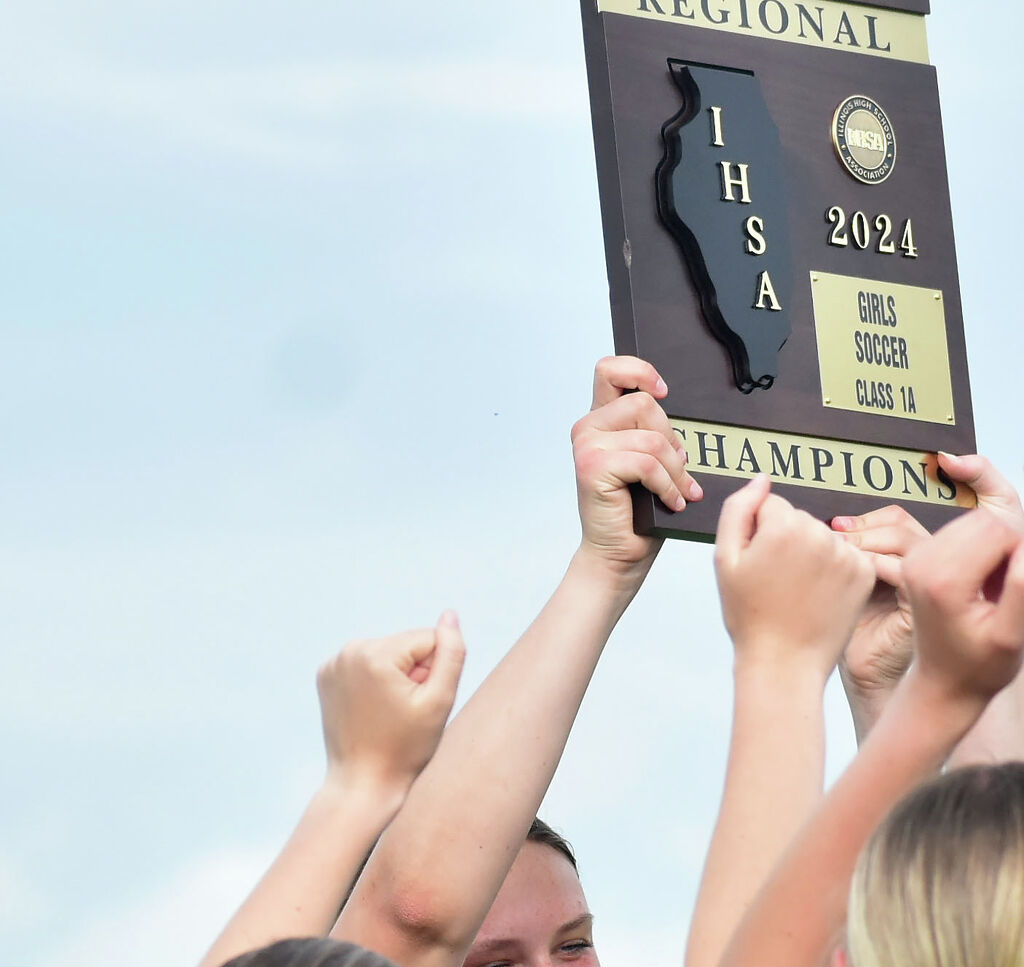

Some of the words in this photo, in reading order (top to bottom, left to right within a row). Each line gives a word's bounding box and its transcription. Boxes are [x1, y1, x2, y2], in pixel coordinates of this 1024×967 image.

[838, 102, 854, 137] ILLINOIS
[853, 99, 872, 110] HIGH
[873, 108, 894, 146] SCHOOL
[845, 156, 889, 179] ASSOCIATION
[825, 206, 919, 258] 2024
[857, 290, 897, 328] GIRLS
[854, 330, 909, 369] SOCCER
[855, 378, 894, 410] CLASS
[900, 385, 917, 414] 1A
